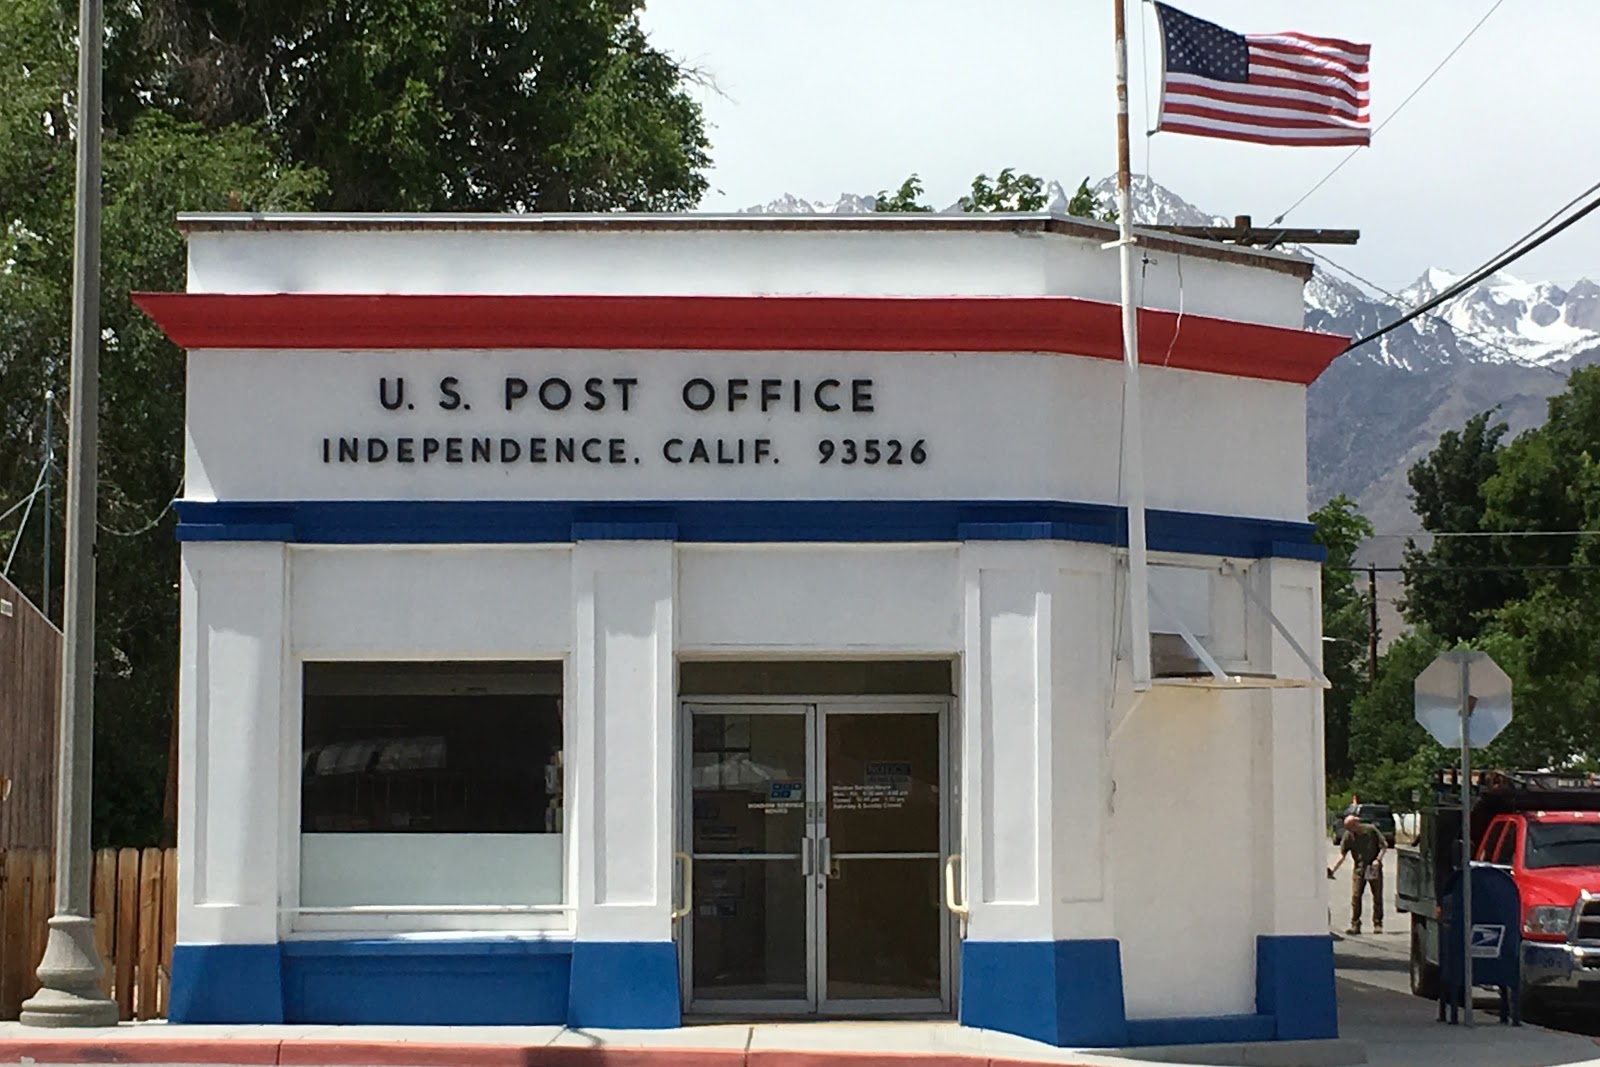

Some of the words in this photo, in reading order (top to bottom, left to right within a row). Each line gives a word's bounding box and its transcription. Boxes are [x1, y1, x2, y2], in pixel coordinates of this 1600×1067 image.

[504, 376, 639, 412] POST
[681, 376, 875, 414] OFFICE
[662, 437, 780, 466] CALIF.
[818, 437, 927, 466] 93526
